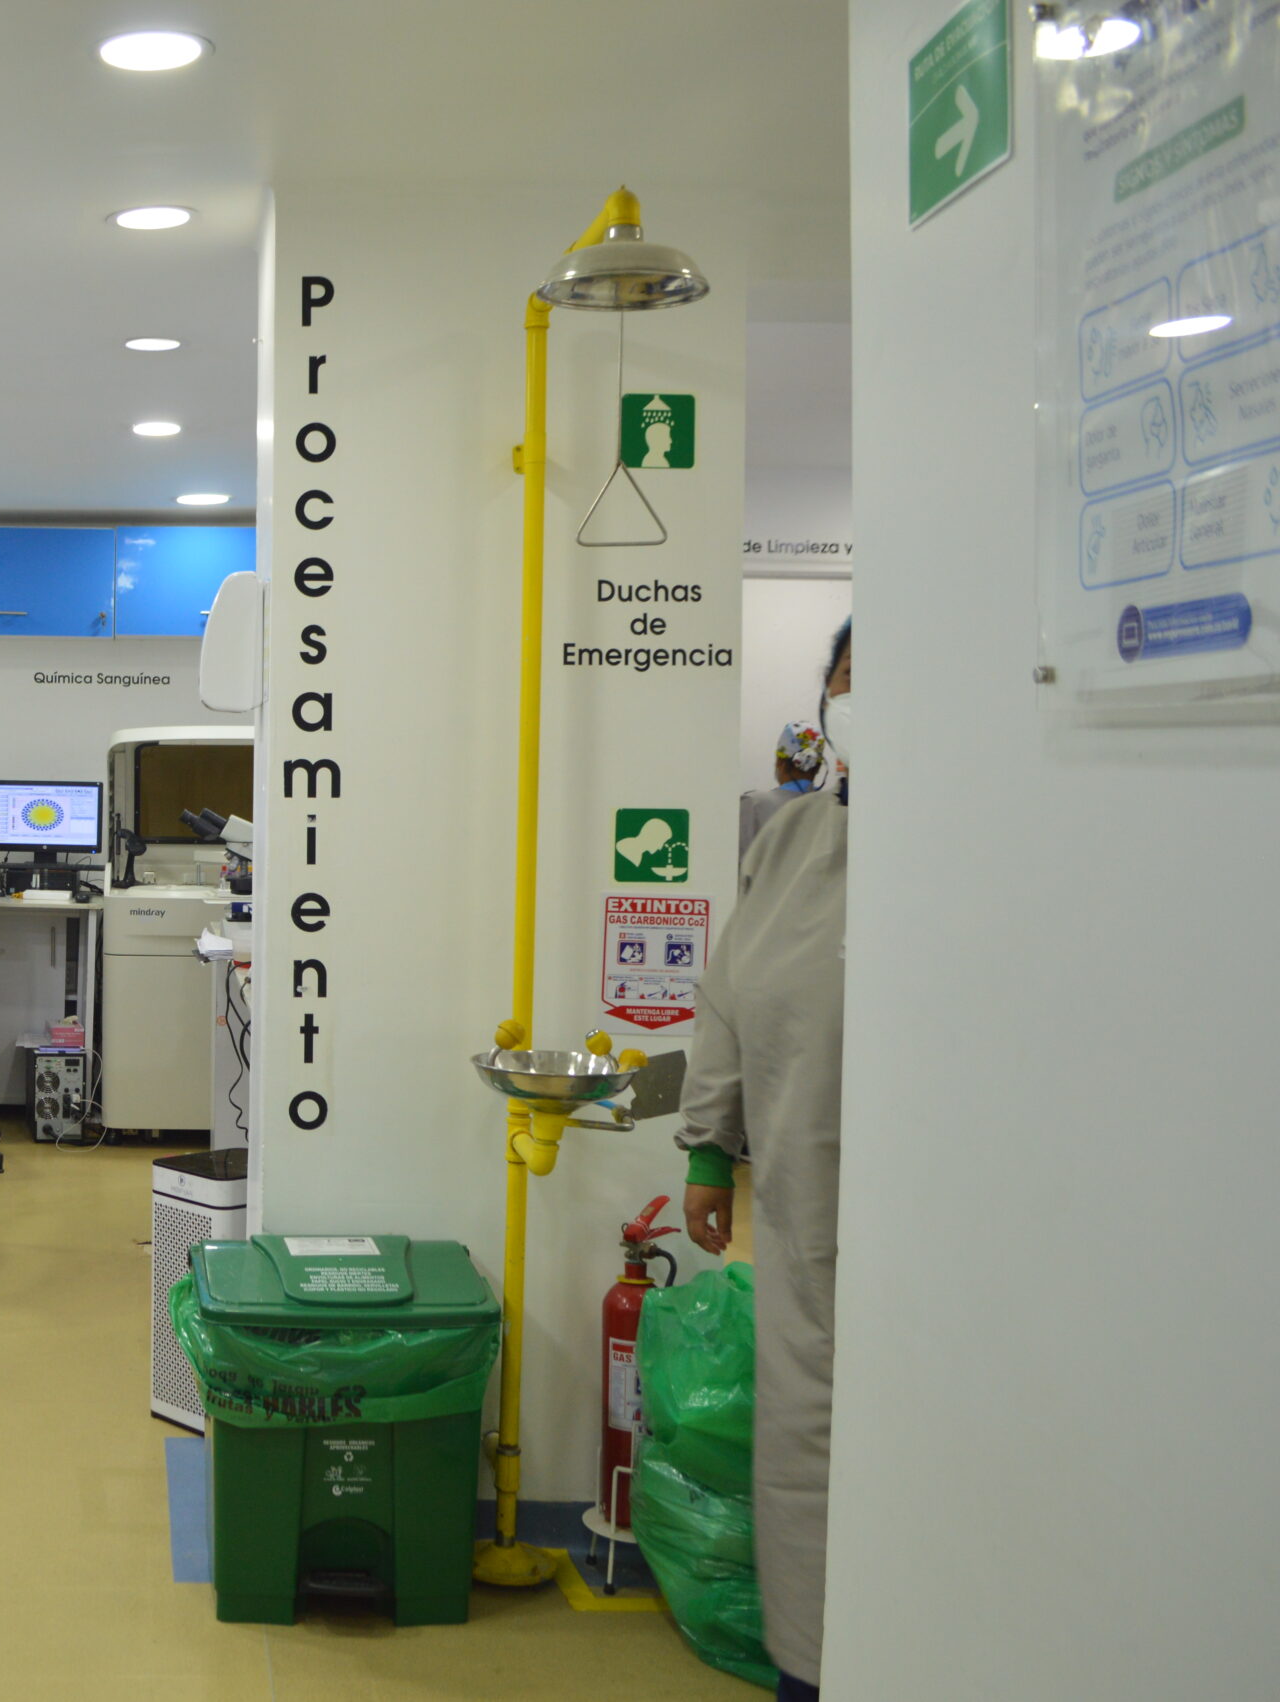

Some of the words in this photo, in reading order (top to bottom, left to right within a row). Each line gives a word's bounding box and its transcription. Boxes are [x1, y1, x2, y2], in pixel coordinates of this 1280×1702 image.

[767, 540, 840, 556] Limpieza
[597, 579, 703, 602] Duchas
[630, 613, 667, 636] de
[562, 642, 733, 673] Emergencia
[33, 671, 93, 685] Química
[96, 672, 171, 688] Sanguínea
[284, 276, 340, 1130] Procesamiento
[129, 908, 166, 919] mindray
[607, 897, 707, 915] EXTINTOR
[608, 914, 628, 925] GAS
[630, 915, 686, 926] CARBONICO
[661, 1008, 680, 1016] LIBRE
[613, 1352, 633, 1363] GAS
